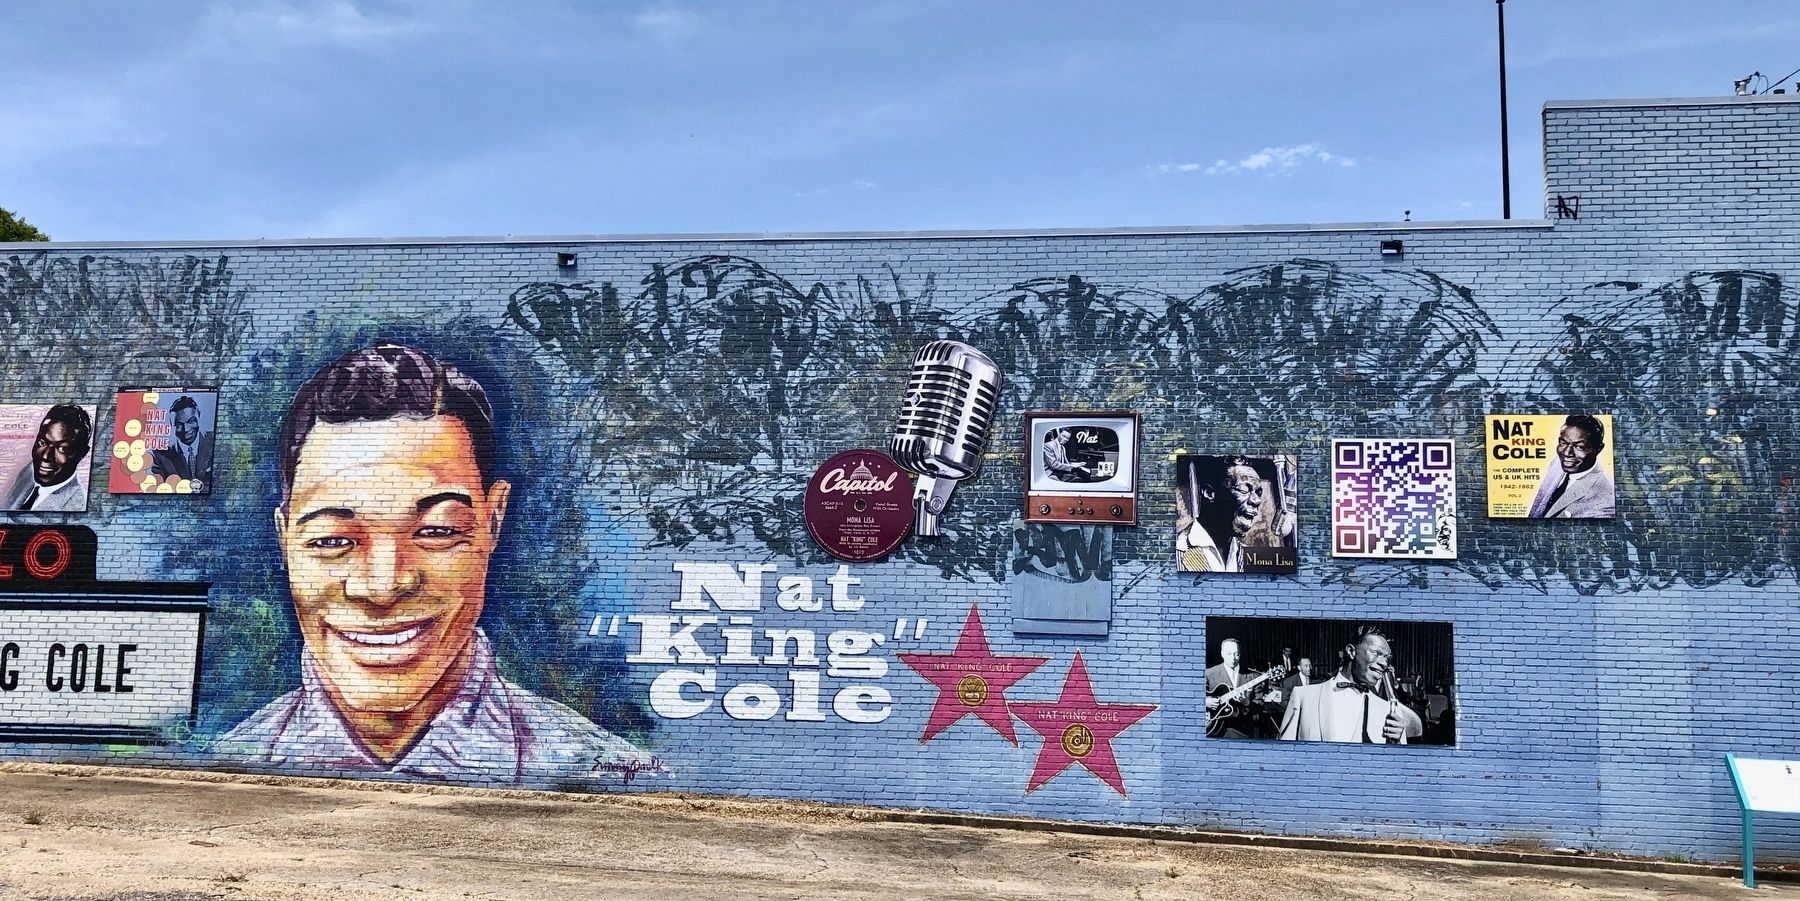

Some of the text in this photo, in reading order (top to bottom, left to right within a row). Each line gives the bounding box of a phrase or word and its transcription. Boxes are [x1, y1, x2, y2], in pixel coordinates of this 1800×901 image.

[146, 410, 167, 422] NAT
[145, 424, 170, 436] KING
[1493, 420, 1533, 440] NAT
[145, 438, 168, 450] COLE
[1076, 432, 1098, 444] Nat
[1493, 444, 1546, 460] COLE
[820, 468, 898, 496] Capitol
[1246, 552, 1294, 566] Mona Lisa
[670, 562, 866, 612] Nat
[588, 616, 928, 678] "King"
[46, 643, 137, 692] COLE
[934, 662, 950, 670] NAT
[989, 663, 1012, 672] COLE
[650, 668, 892, 722] Cole
[1038, 711, 1058, 720] NAT
[1094, 712, 1119, 721] COLE
